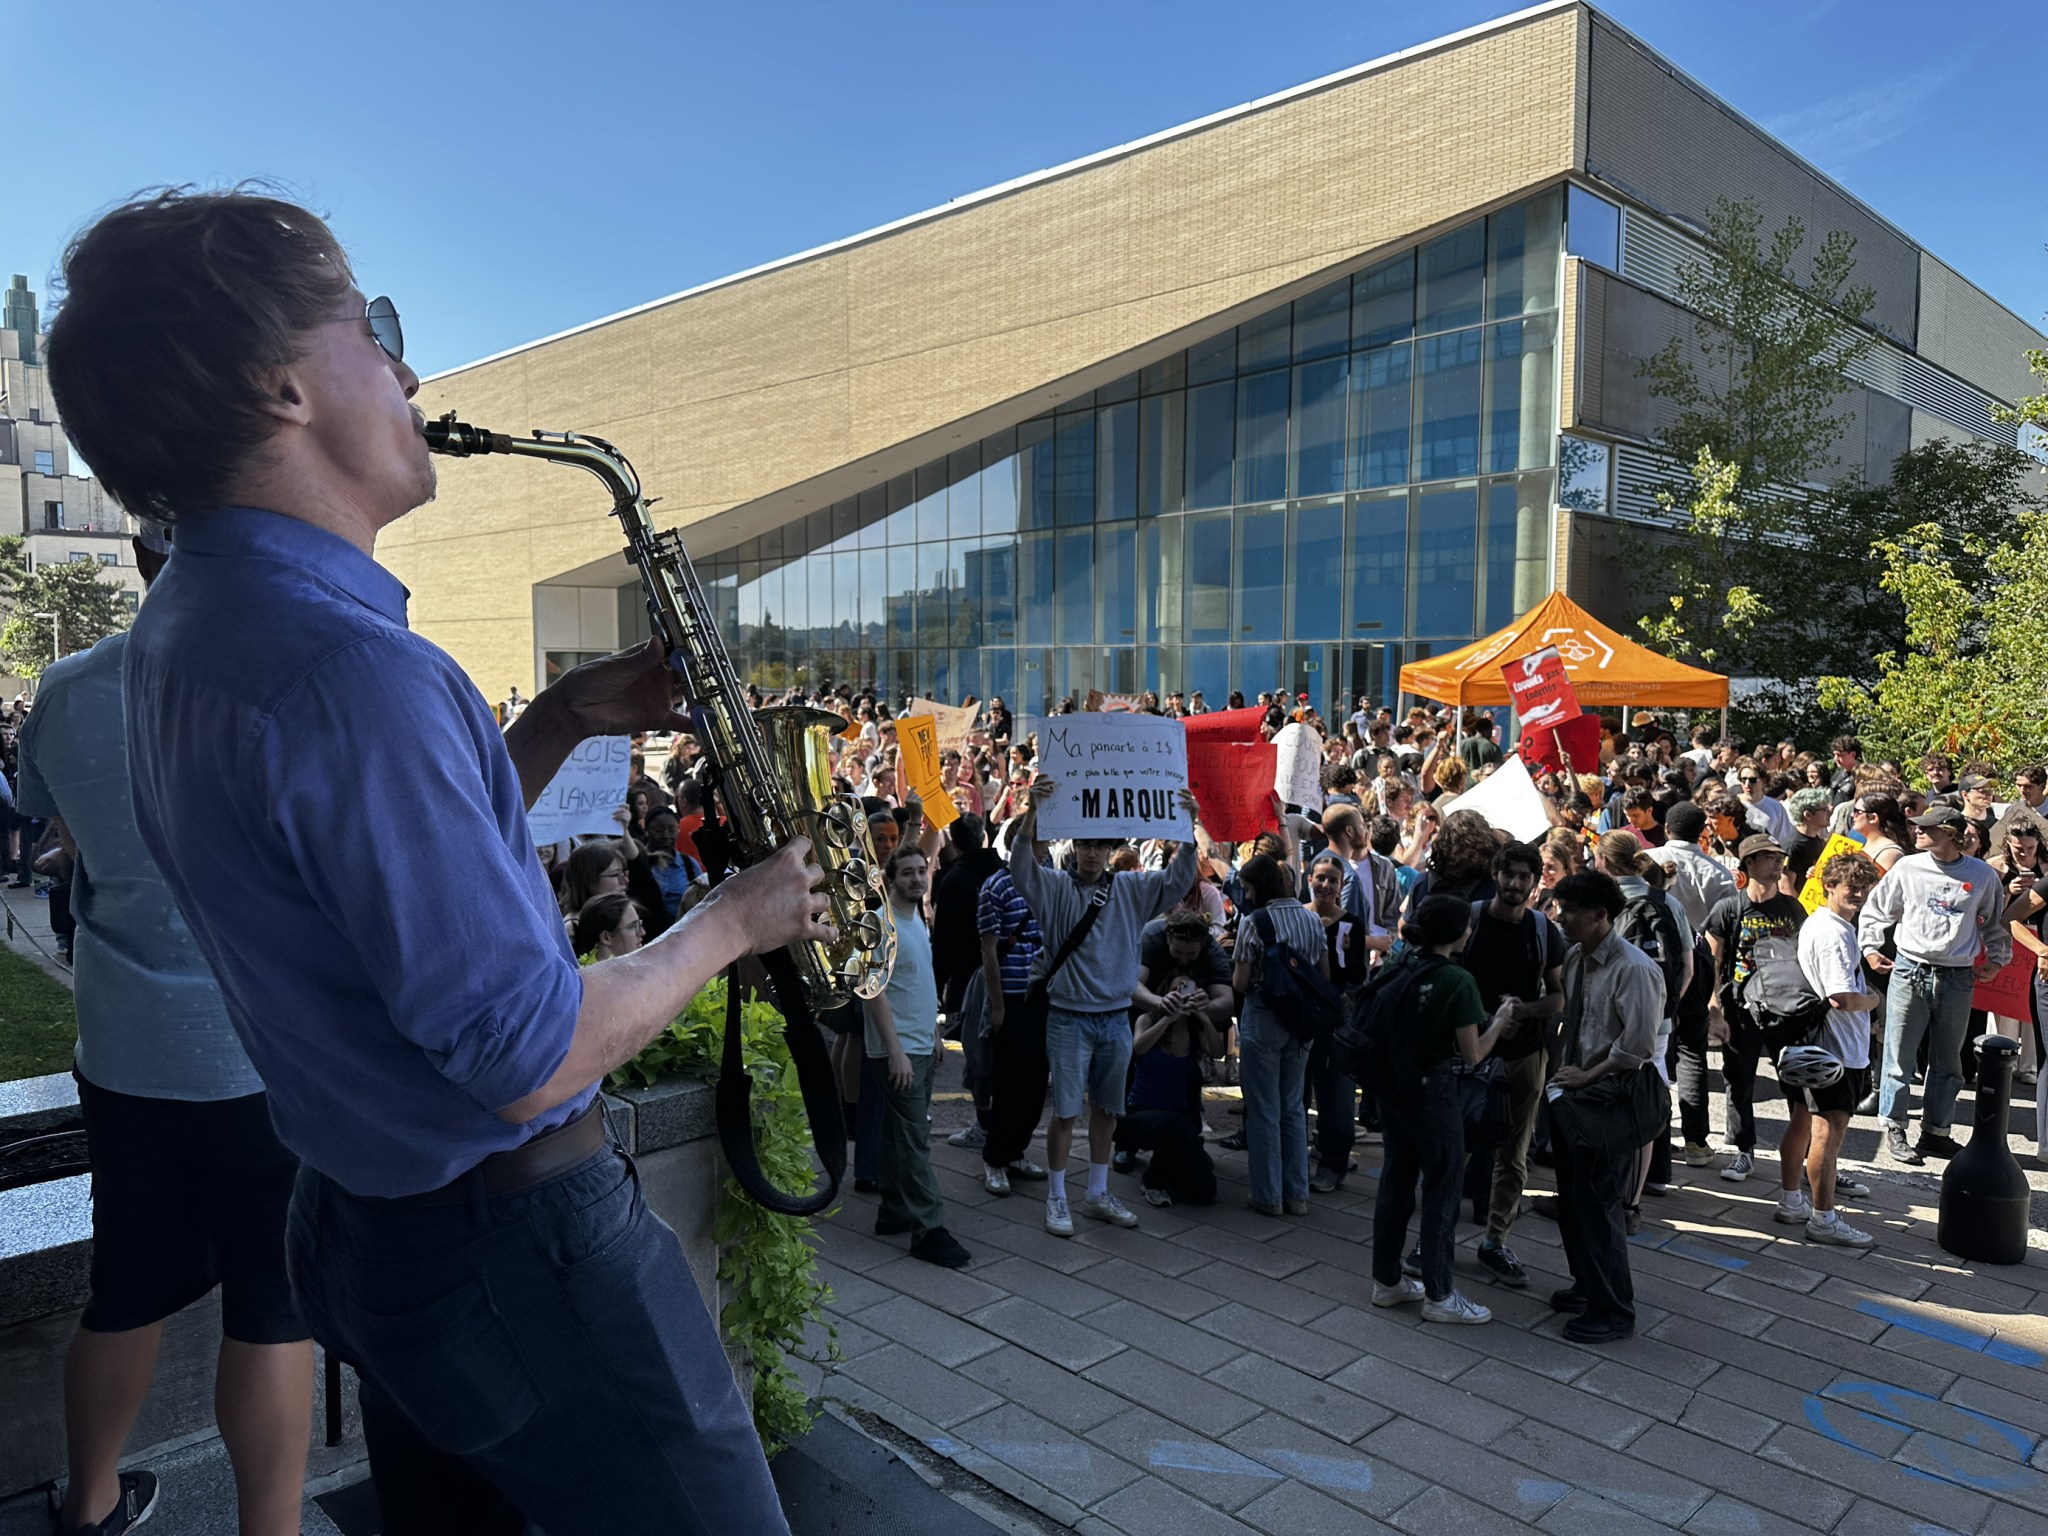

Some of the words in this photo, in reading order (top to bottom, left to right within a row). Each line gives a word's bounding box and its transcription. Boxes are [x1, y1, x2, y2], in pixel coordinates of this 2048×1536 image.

[1546, 668, 1560, 681] pas
[1576, 691, 1636, 699] LYTECHNIQUE
[1043, 727, 1083, 762] Ma
[1090, 741, 1135, 759] pancarte
[1142, 741, 1149, 752] à
[1156, 741, 1172, 755] 1$
[1085, 768, 1100, 779] plus
[1104, 768, 1119, 776] belle
[1123, 770, 1134, 779] que
[1140, 768, 1160, 776] votre
[1165, 769, 1185, 783] image
[1301, 778, 1315, 790] ET
[1082, 788, 1177, 822] MARQUE
[1201, 788, 1247, 807] ÂCHE
